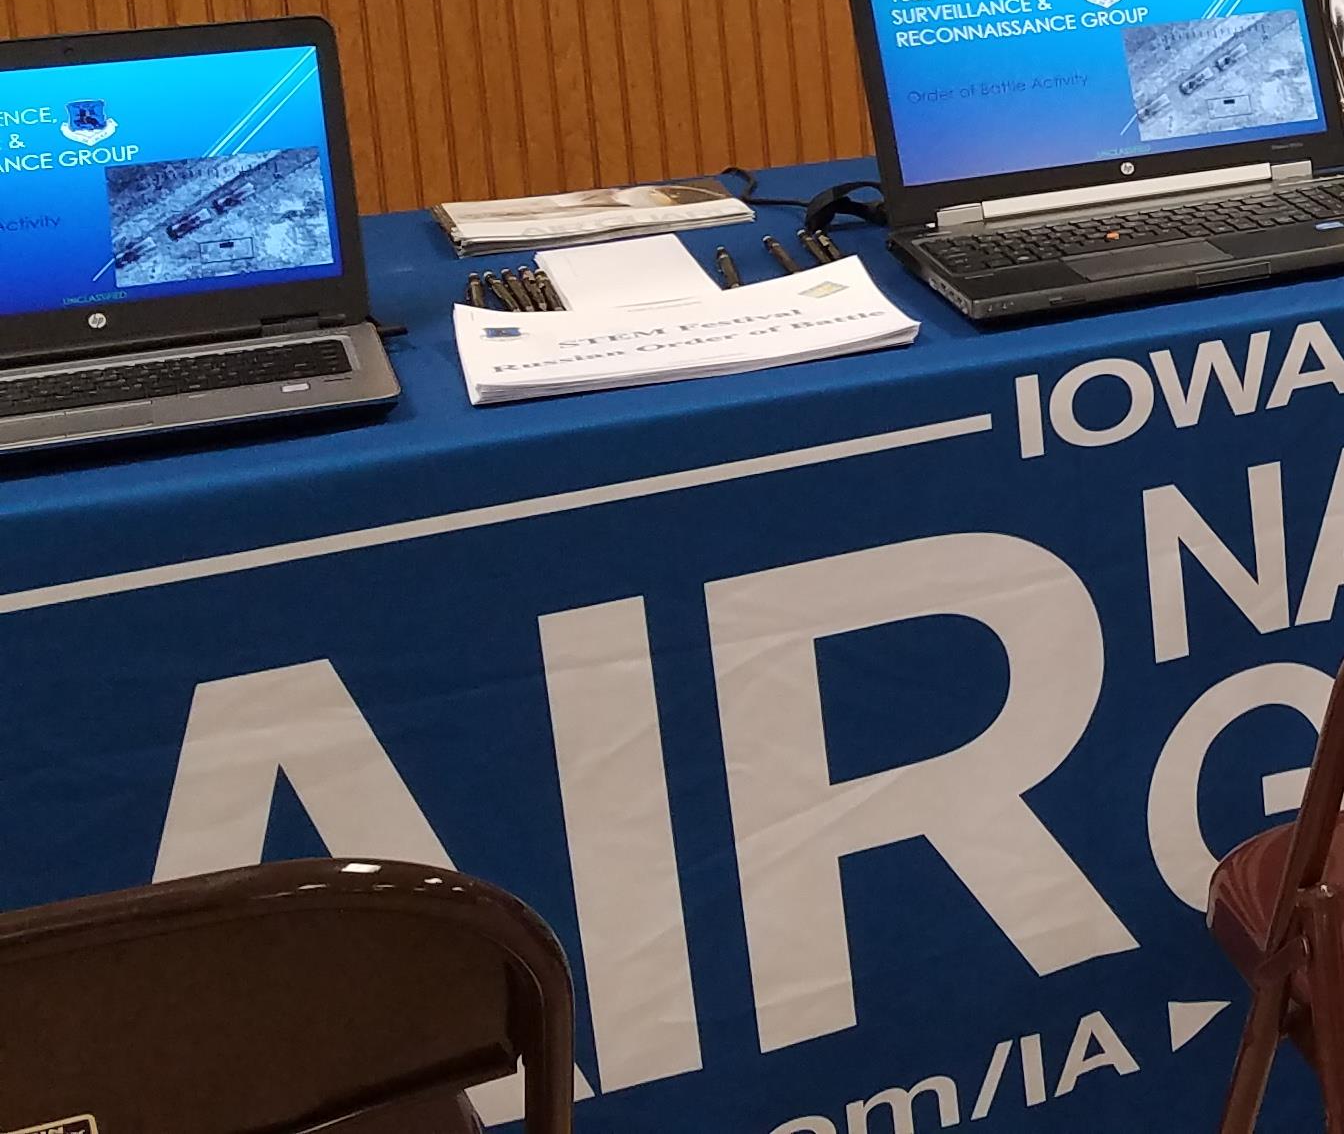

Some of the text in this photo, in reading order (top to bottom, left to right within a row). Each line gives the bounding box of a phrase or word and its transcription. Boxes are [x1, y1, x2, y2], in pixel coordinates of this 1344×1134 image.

[896, 7, 1149, 48] RECONNAISSANCE GROUP
[907, 89, 954, 104] Order
[9, 133, 25, 149] &
[59, 145, 139, 167] GROUP
[492, 308, 886, 373] Russian Order of Battle
[559, 307, 802, 349] STEM Festival
[151, 531, 1142, 1128] AIR
[768, 1011, 1142, 1134] m/IA
